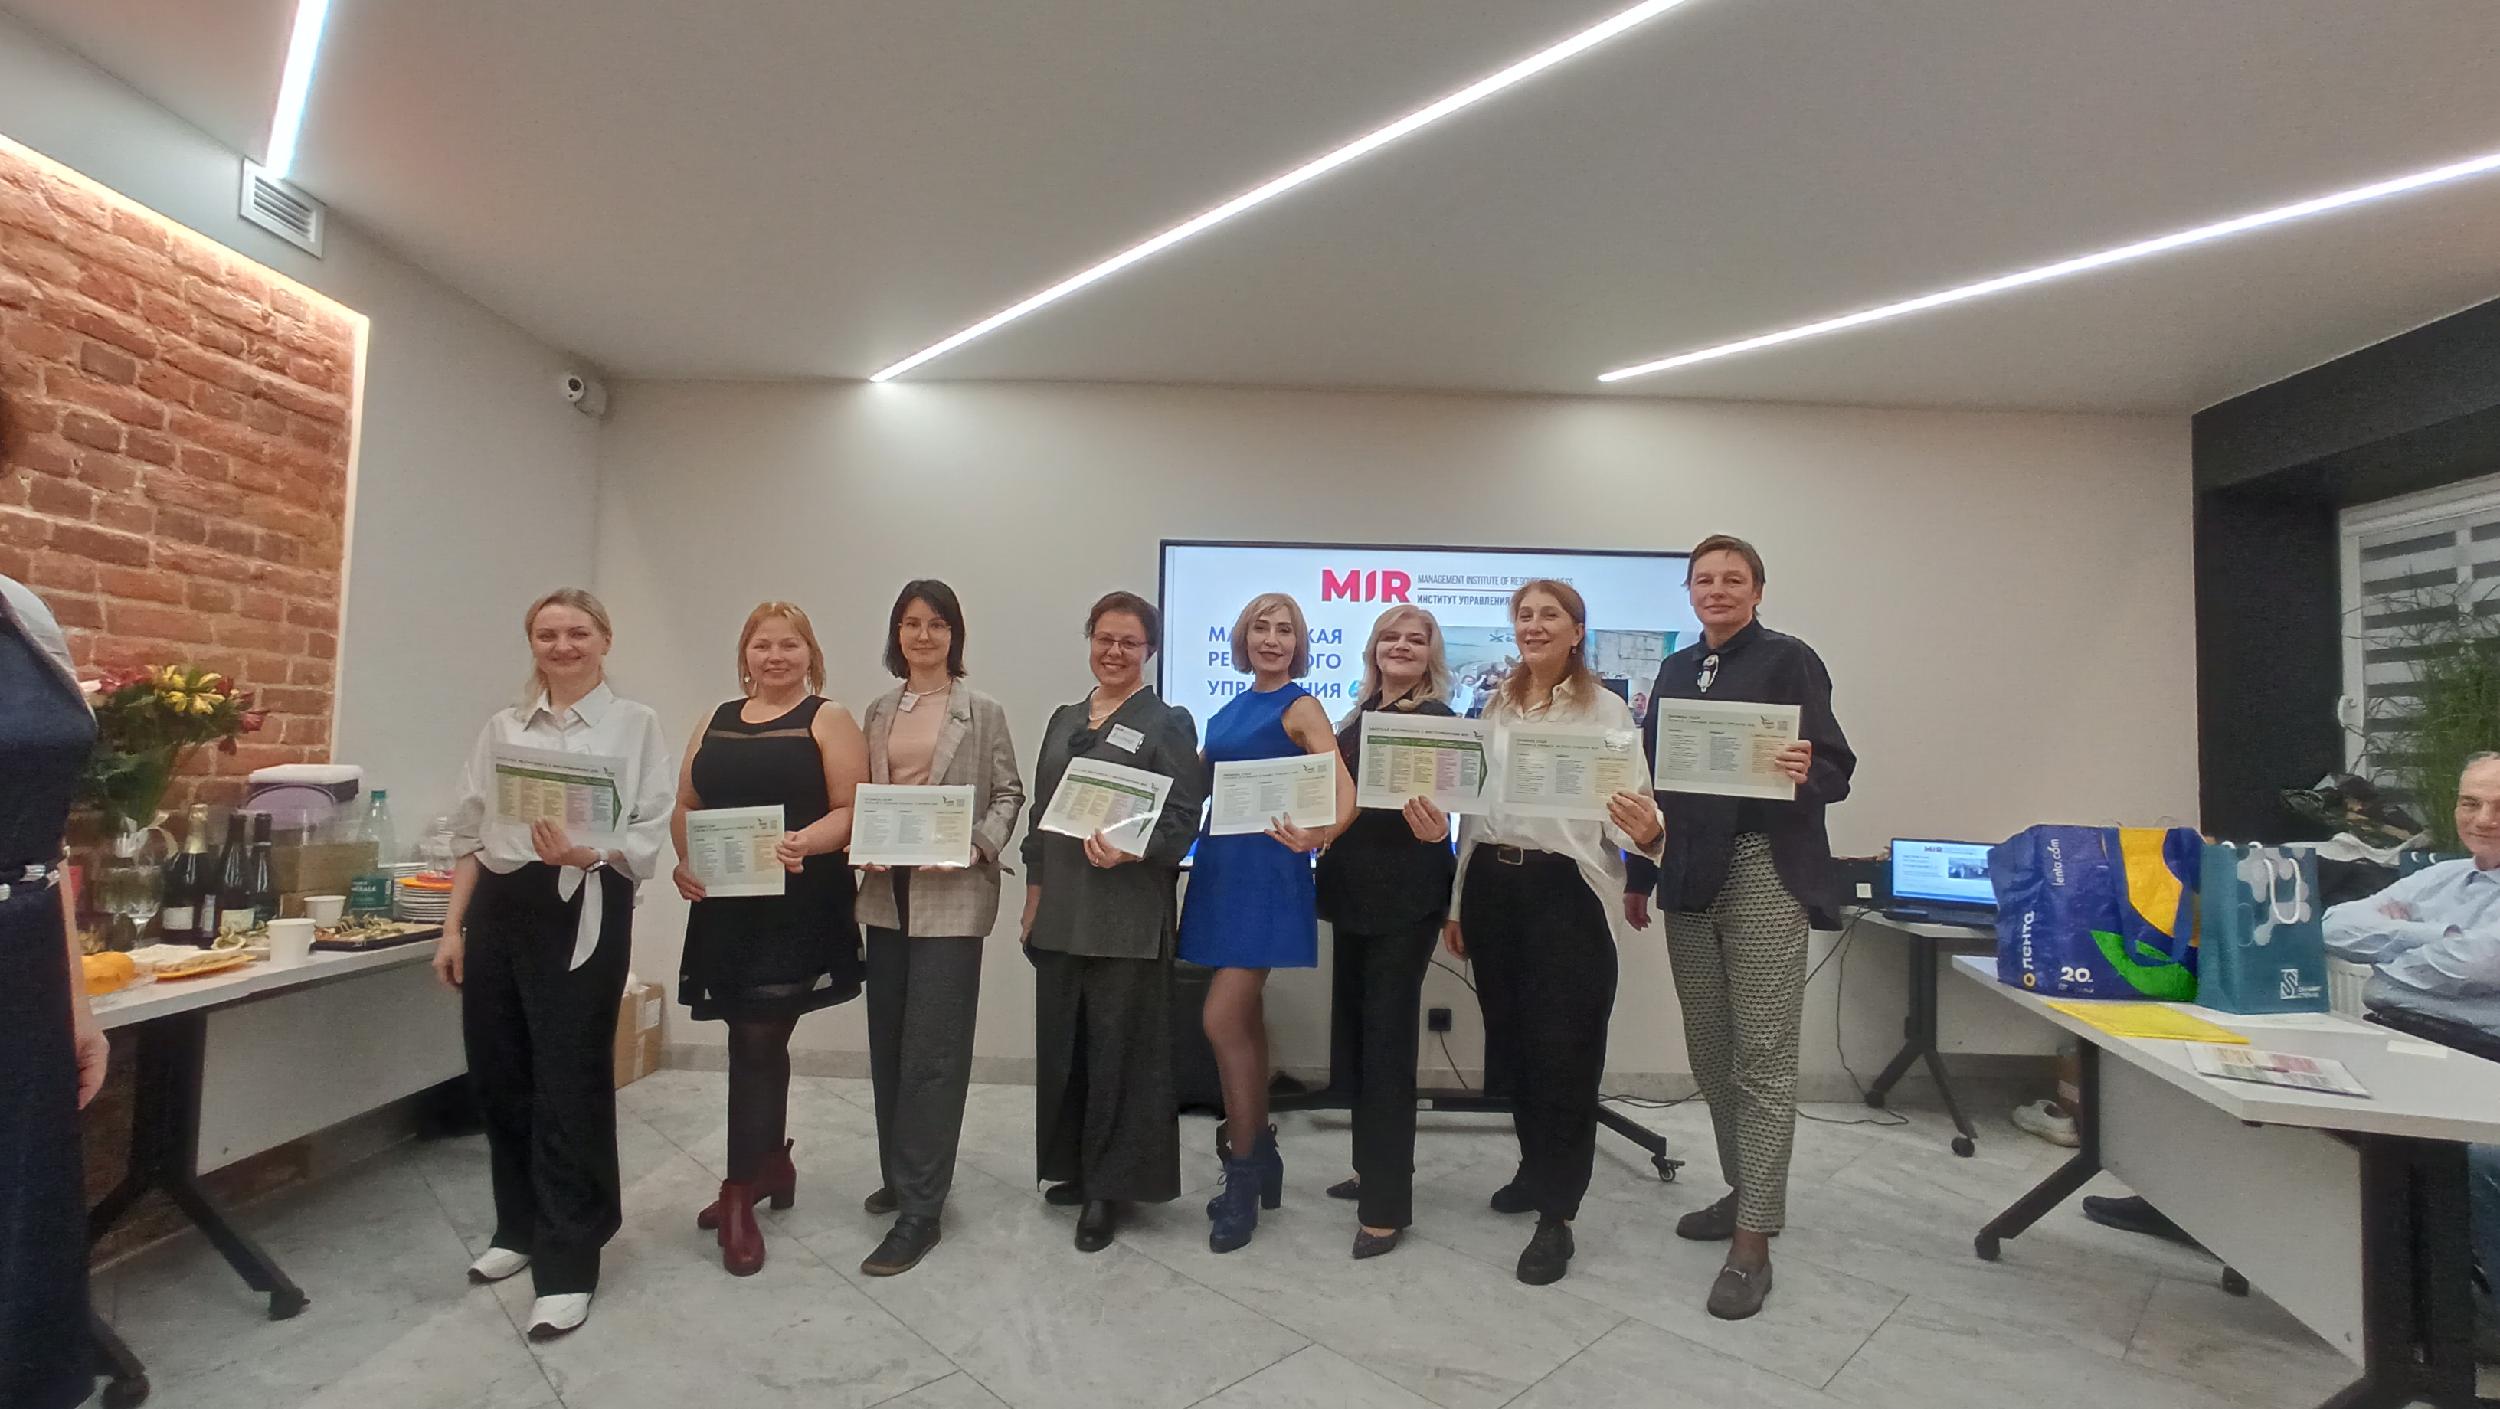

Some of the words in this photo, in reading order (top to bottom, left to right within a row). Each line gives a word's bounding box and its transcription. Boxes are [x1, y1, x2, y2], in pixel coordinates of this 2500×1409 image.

[1418, 574, 1464, 585] MANAGEMENT
[1466, 575, 1499, 585] INSTITUTE
[1500, 576, 1509, 586] OF
[1322, 570, 1411, 603] MIR
[1417, 594, 1457, 604] ИНСТИТУТ
[1458, 595, 1510, 606] УПРАВЛЕНИЯ
